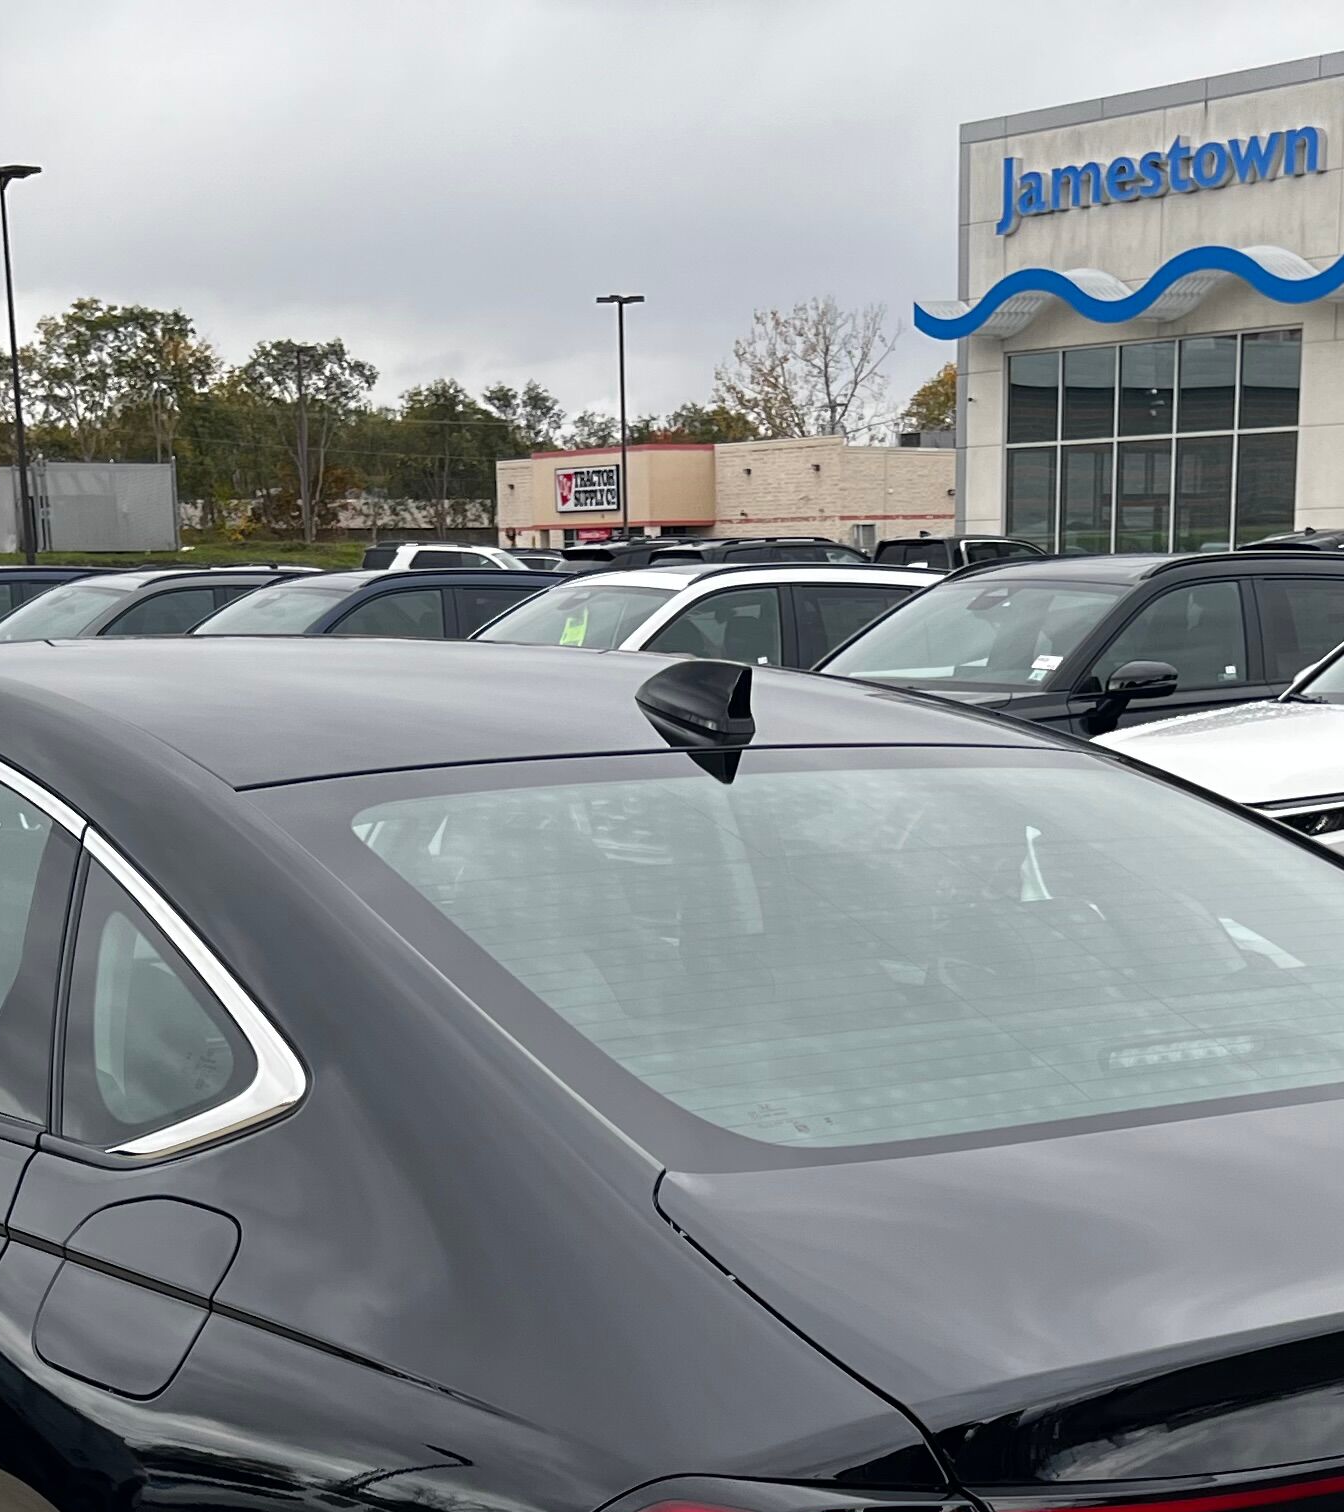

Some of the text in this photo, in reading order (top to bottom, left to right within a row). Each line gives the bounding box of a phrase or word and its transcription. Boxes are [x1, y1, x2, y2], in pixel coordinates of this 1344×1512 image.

[996, 126, 1327, 236] Jamestown
[574, 469, 615, 488] TRACTOR
[574, 489, 604, 507] SUPPLY
